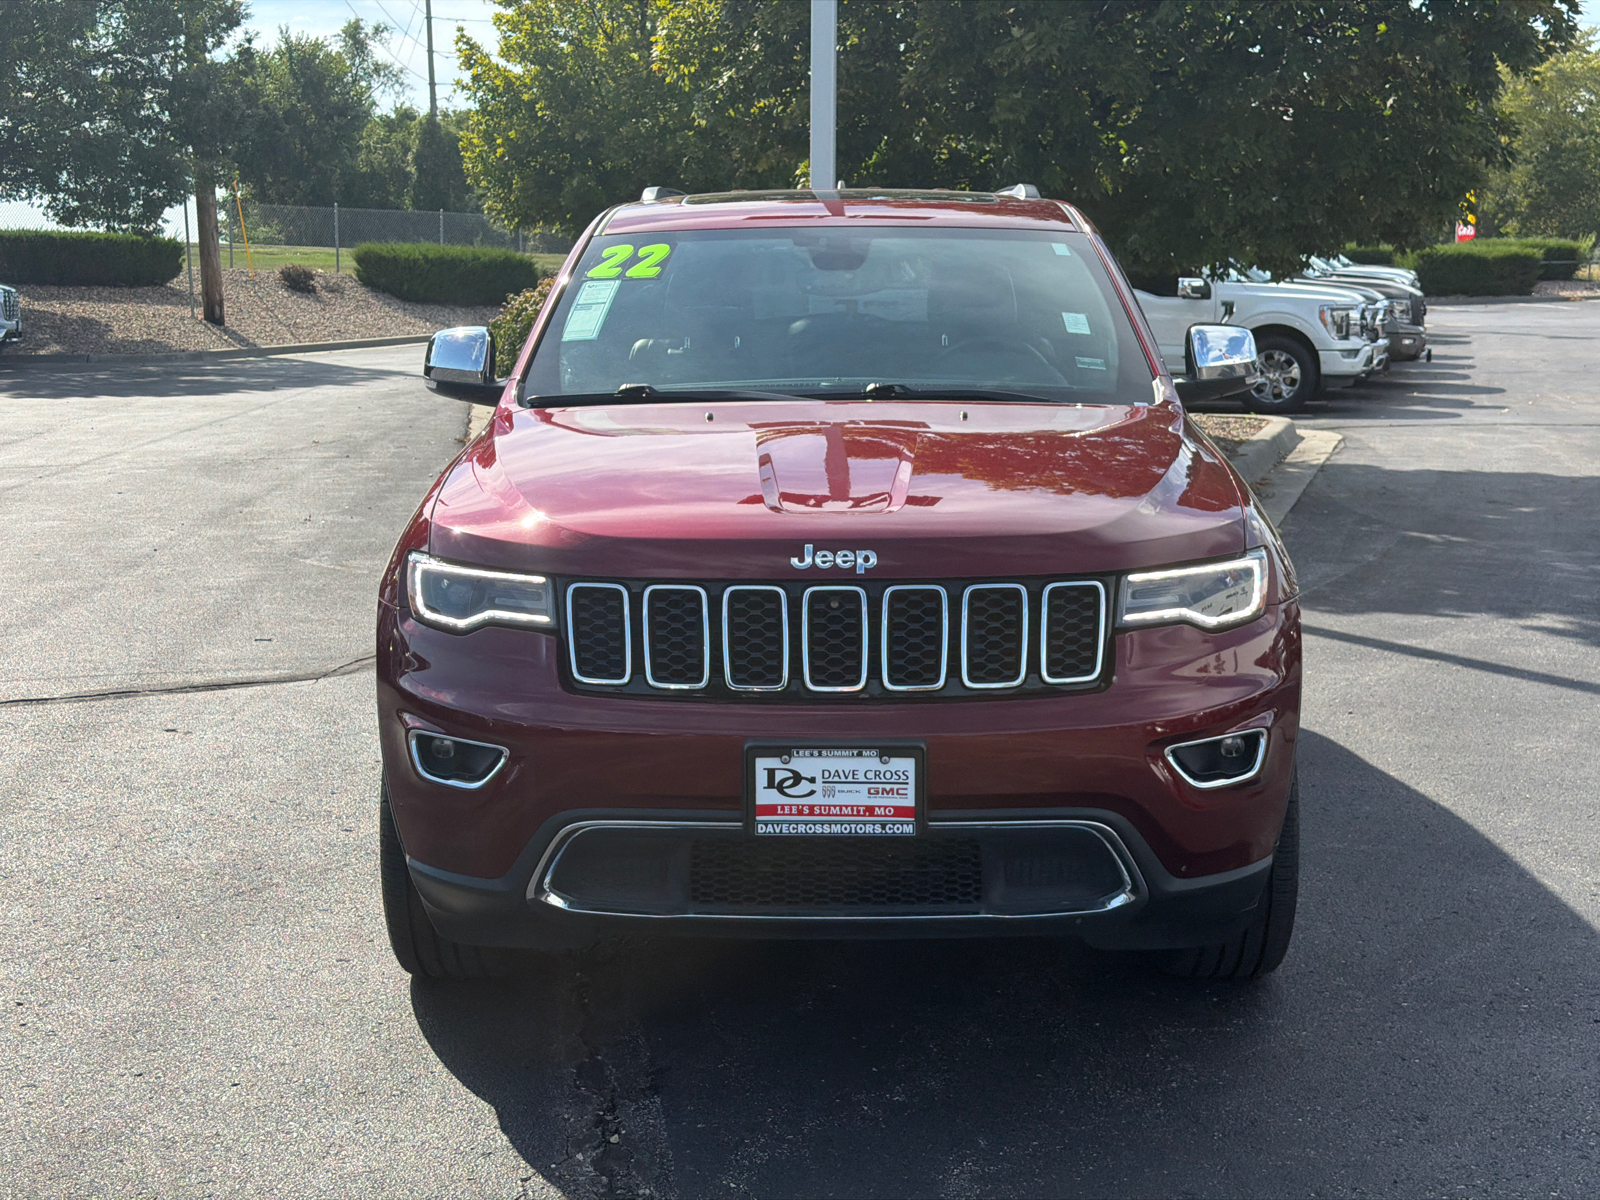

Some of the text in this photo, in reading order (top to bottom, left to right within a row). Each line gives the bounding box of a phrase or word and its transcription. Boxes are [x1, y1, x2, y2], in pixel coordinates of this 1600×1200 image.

[586, 243, 671, 279] 22
[790, 543, 878, 575] Jeep
[821, 769, 910, 781] DAVE CROSS
[867, 787, 909, 796] GMC
[777, 805, 895, 816] LEE'S SUMMIT, MO
[757, 823, 914, 834] DAVECROSSMOTORS.COM
